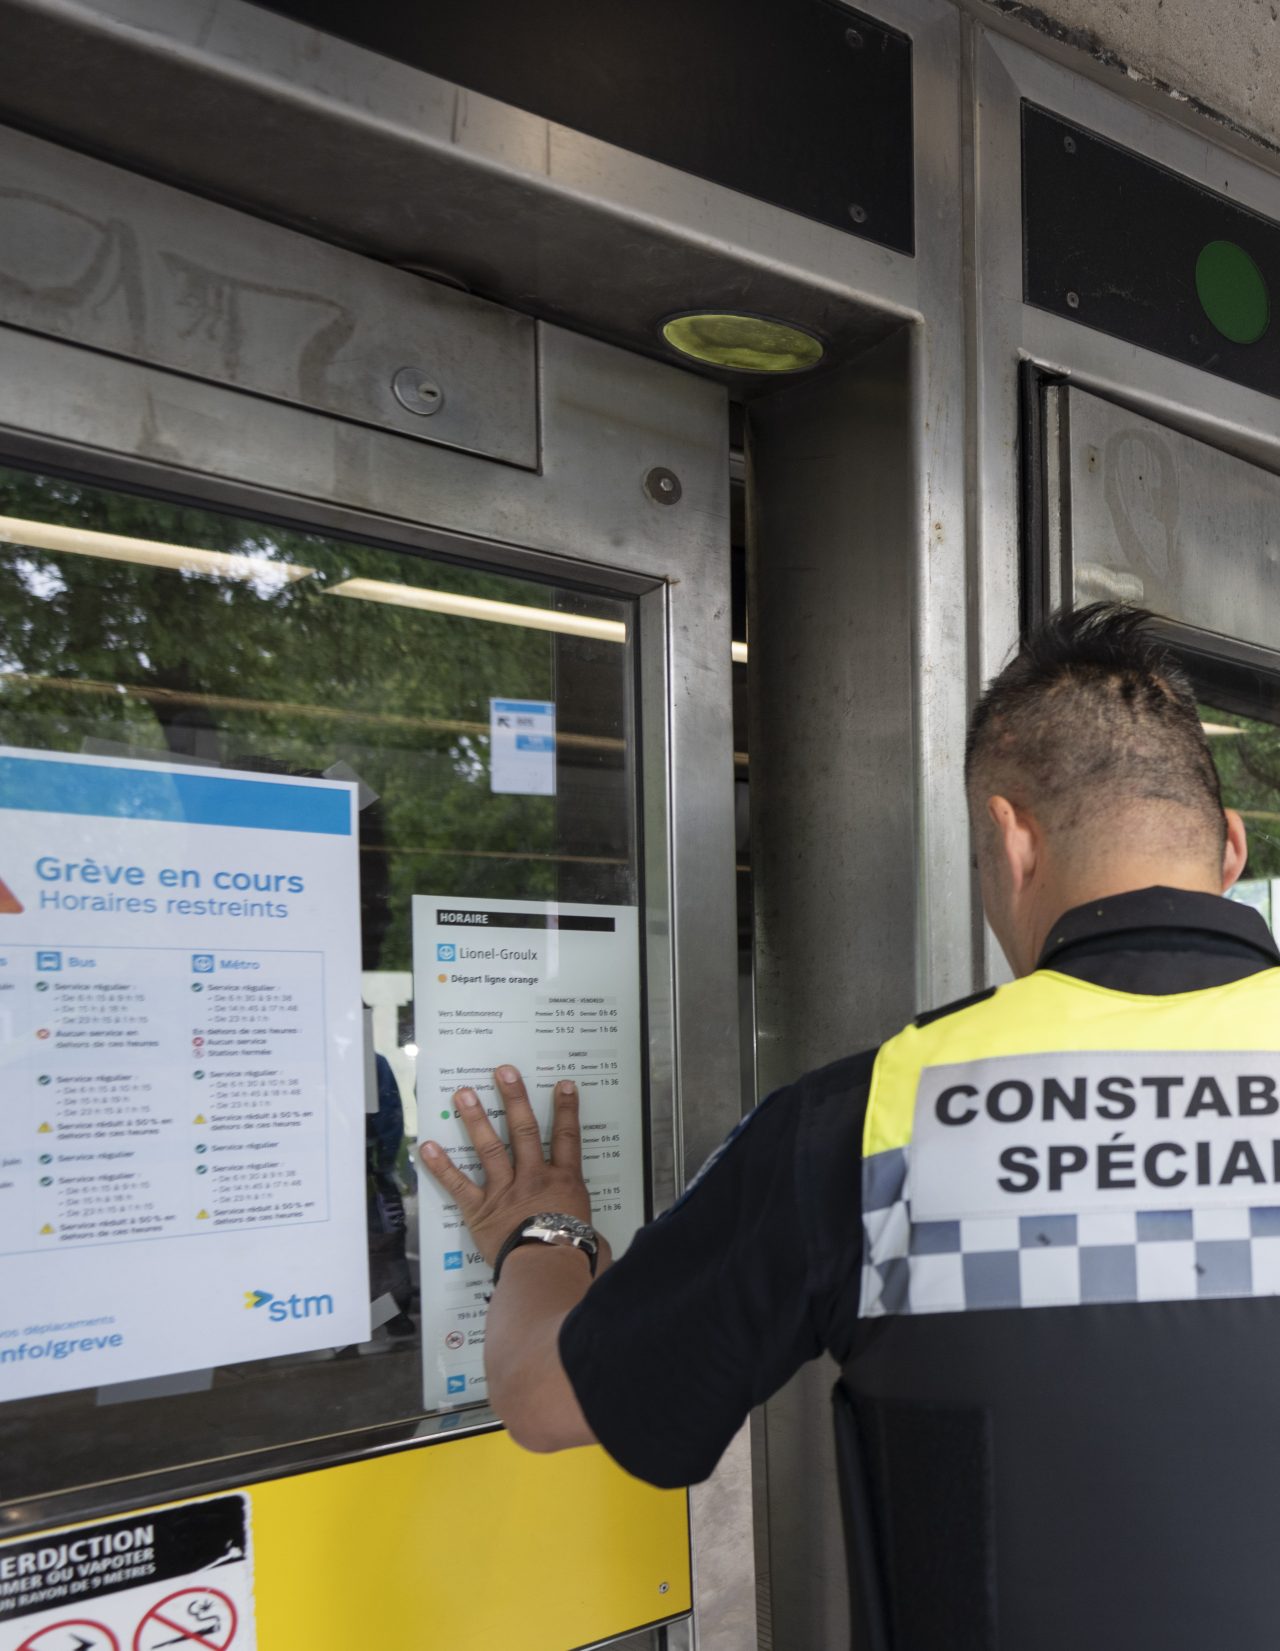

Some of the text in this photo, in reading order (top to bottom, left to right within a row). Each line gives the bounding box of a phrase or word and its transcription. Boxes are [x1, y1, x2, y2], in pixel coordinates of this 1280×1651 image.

[35, 857, 304, 893] Grève en cours
[40, 890, 288, 918] Horaires restreints
[440, 912, 489, 924] HORAIRE
[68, 957, 96, 967] Bus
[460, 947, 538, 960] Lionel-Groulx
[220, 960, 260, 970] Métro
[451, 974, 539, 985] Départ ligne orange
[269, 1294, 333, 1322] stm
[46, 1566, 74, 1585] OU
[77, 1547, 155, 1577] VAPOTER
[18, 1584, 68, 1607] RAYON
[69, 1579, 90, 1594] DE
[92, 1575, 102, 1589] 9
